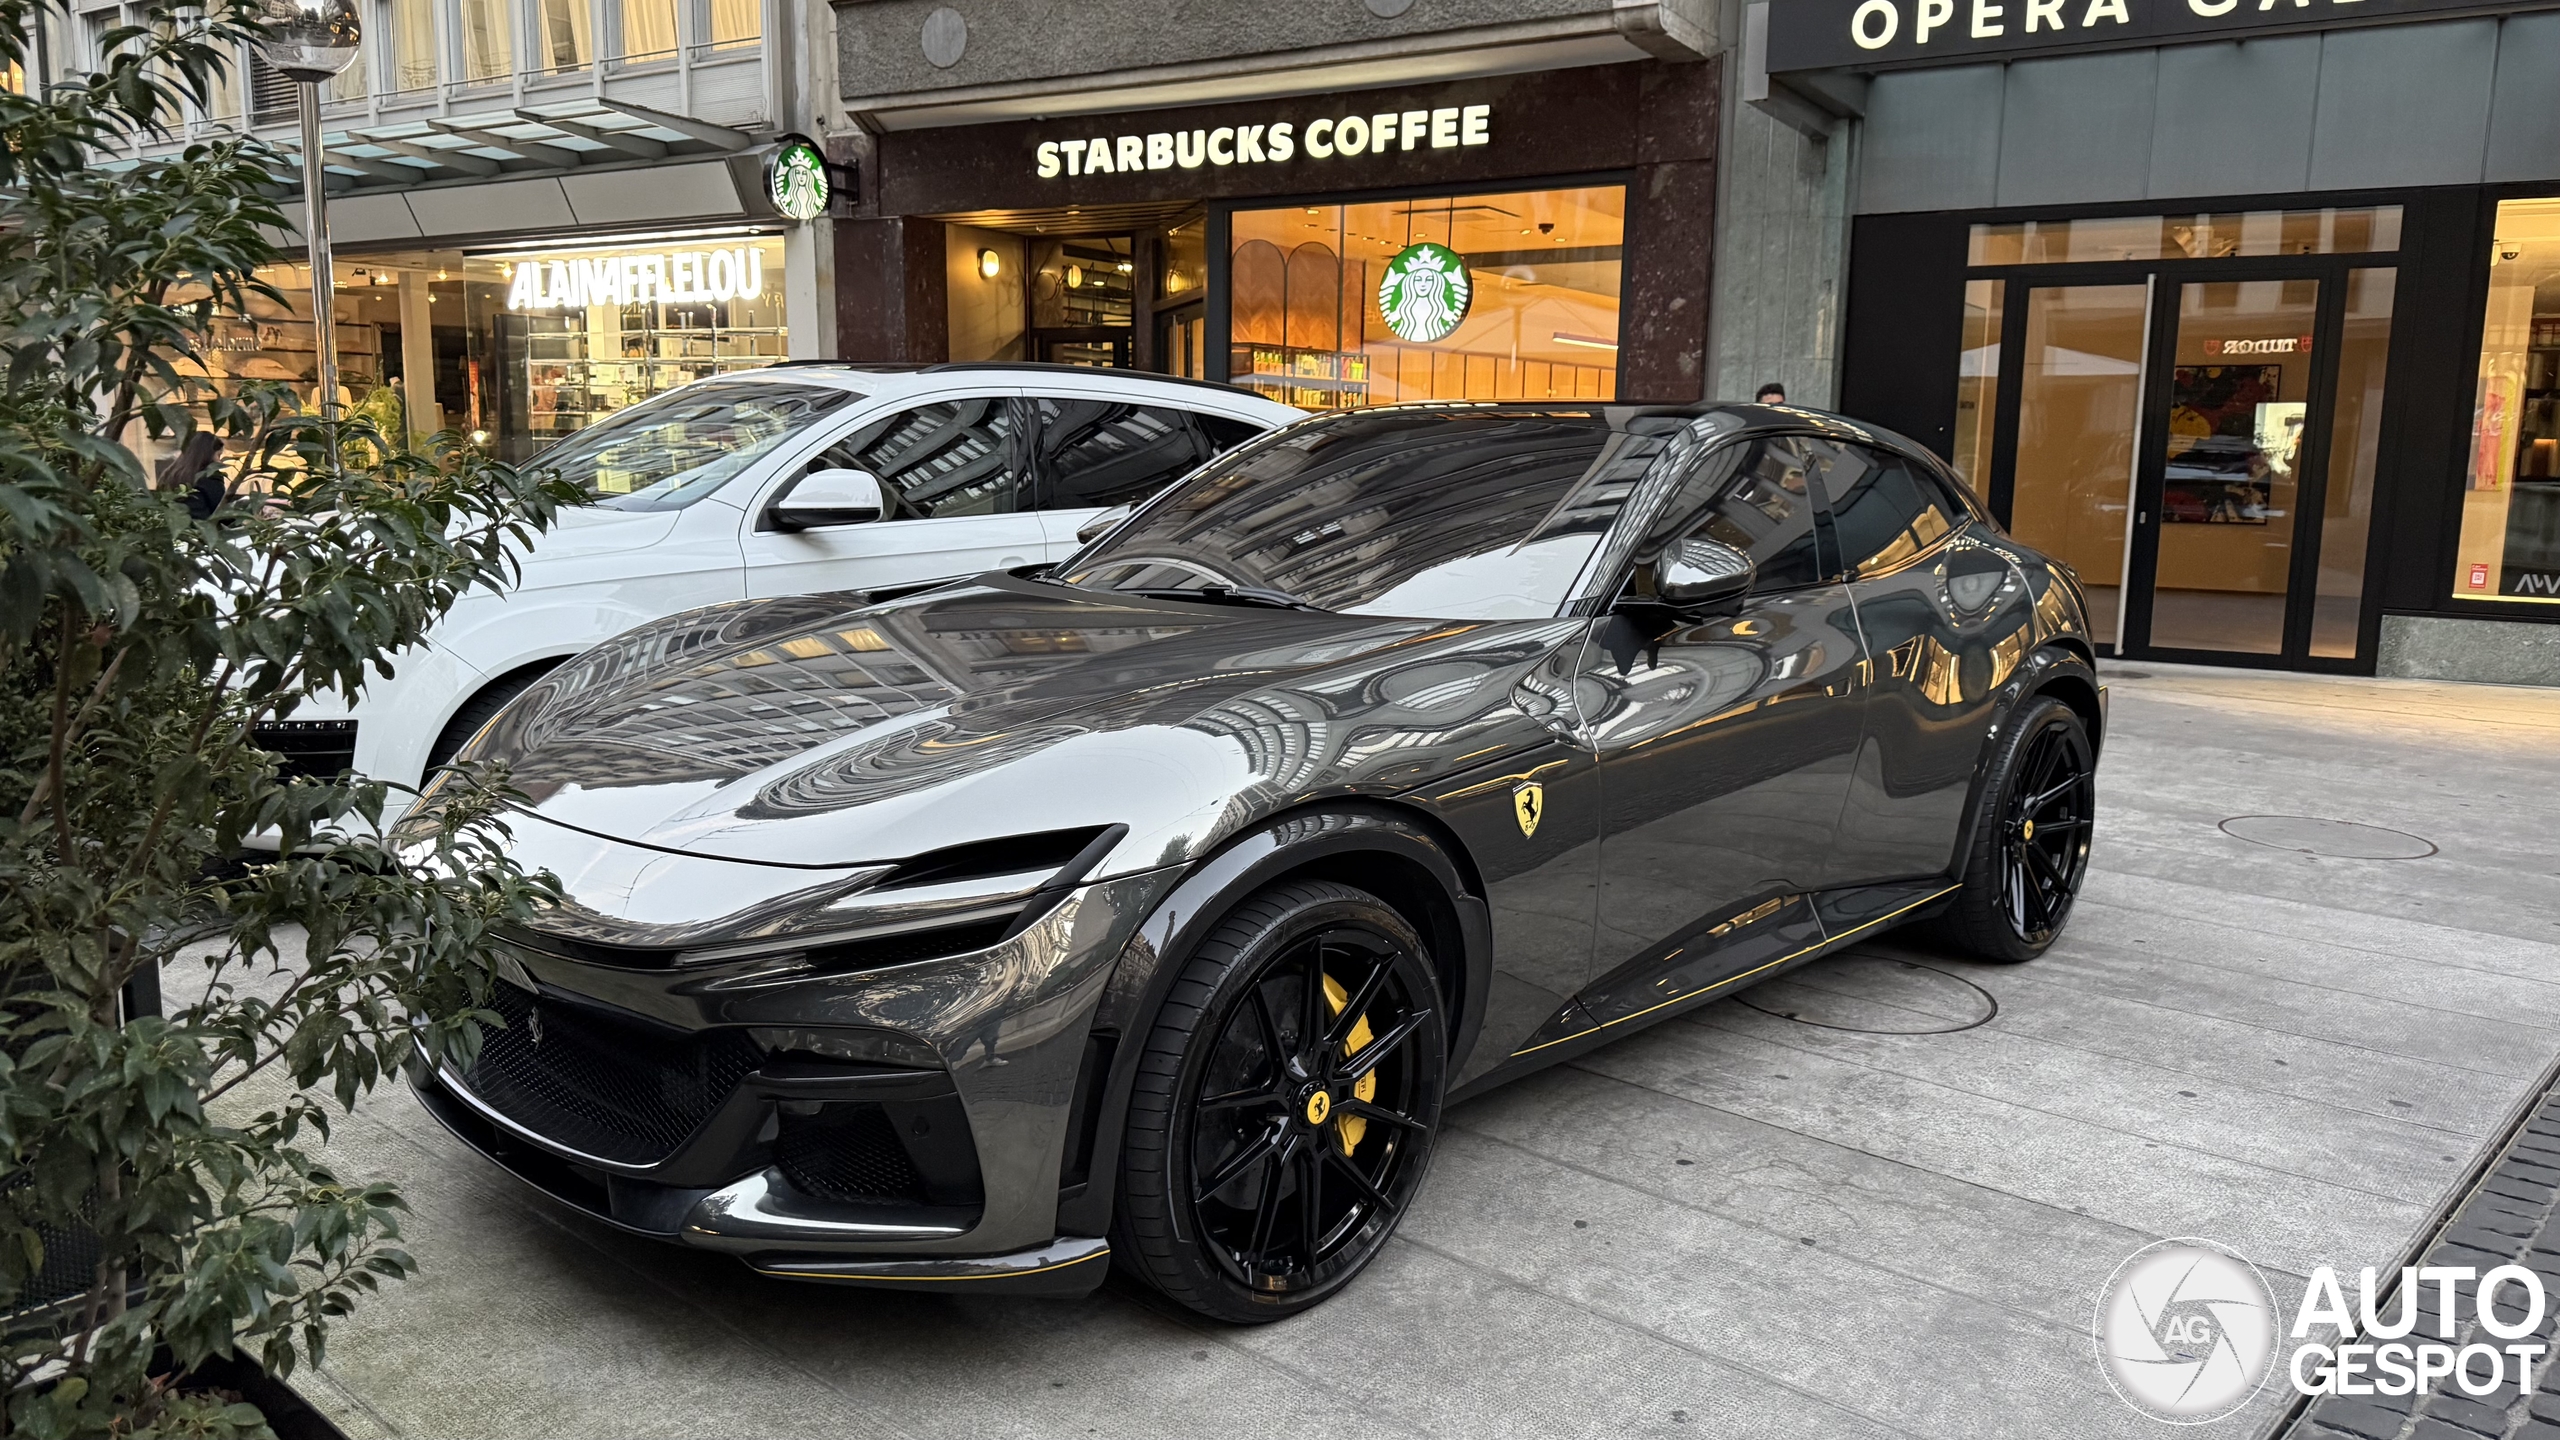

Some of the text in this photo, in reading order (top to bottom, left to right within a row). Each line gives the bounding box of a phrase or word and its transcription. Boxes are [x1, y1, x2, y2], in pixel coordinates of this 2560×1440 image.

[1851, 0, 2130, 49] OPERA
[1037, 104, 1490, 178] STARBUCKS COFFEE
